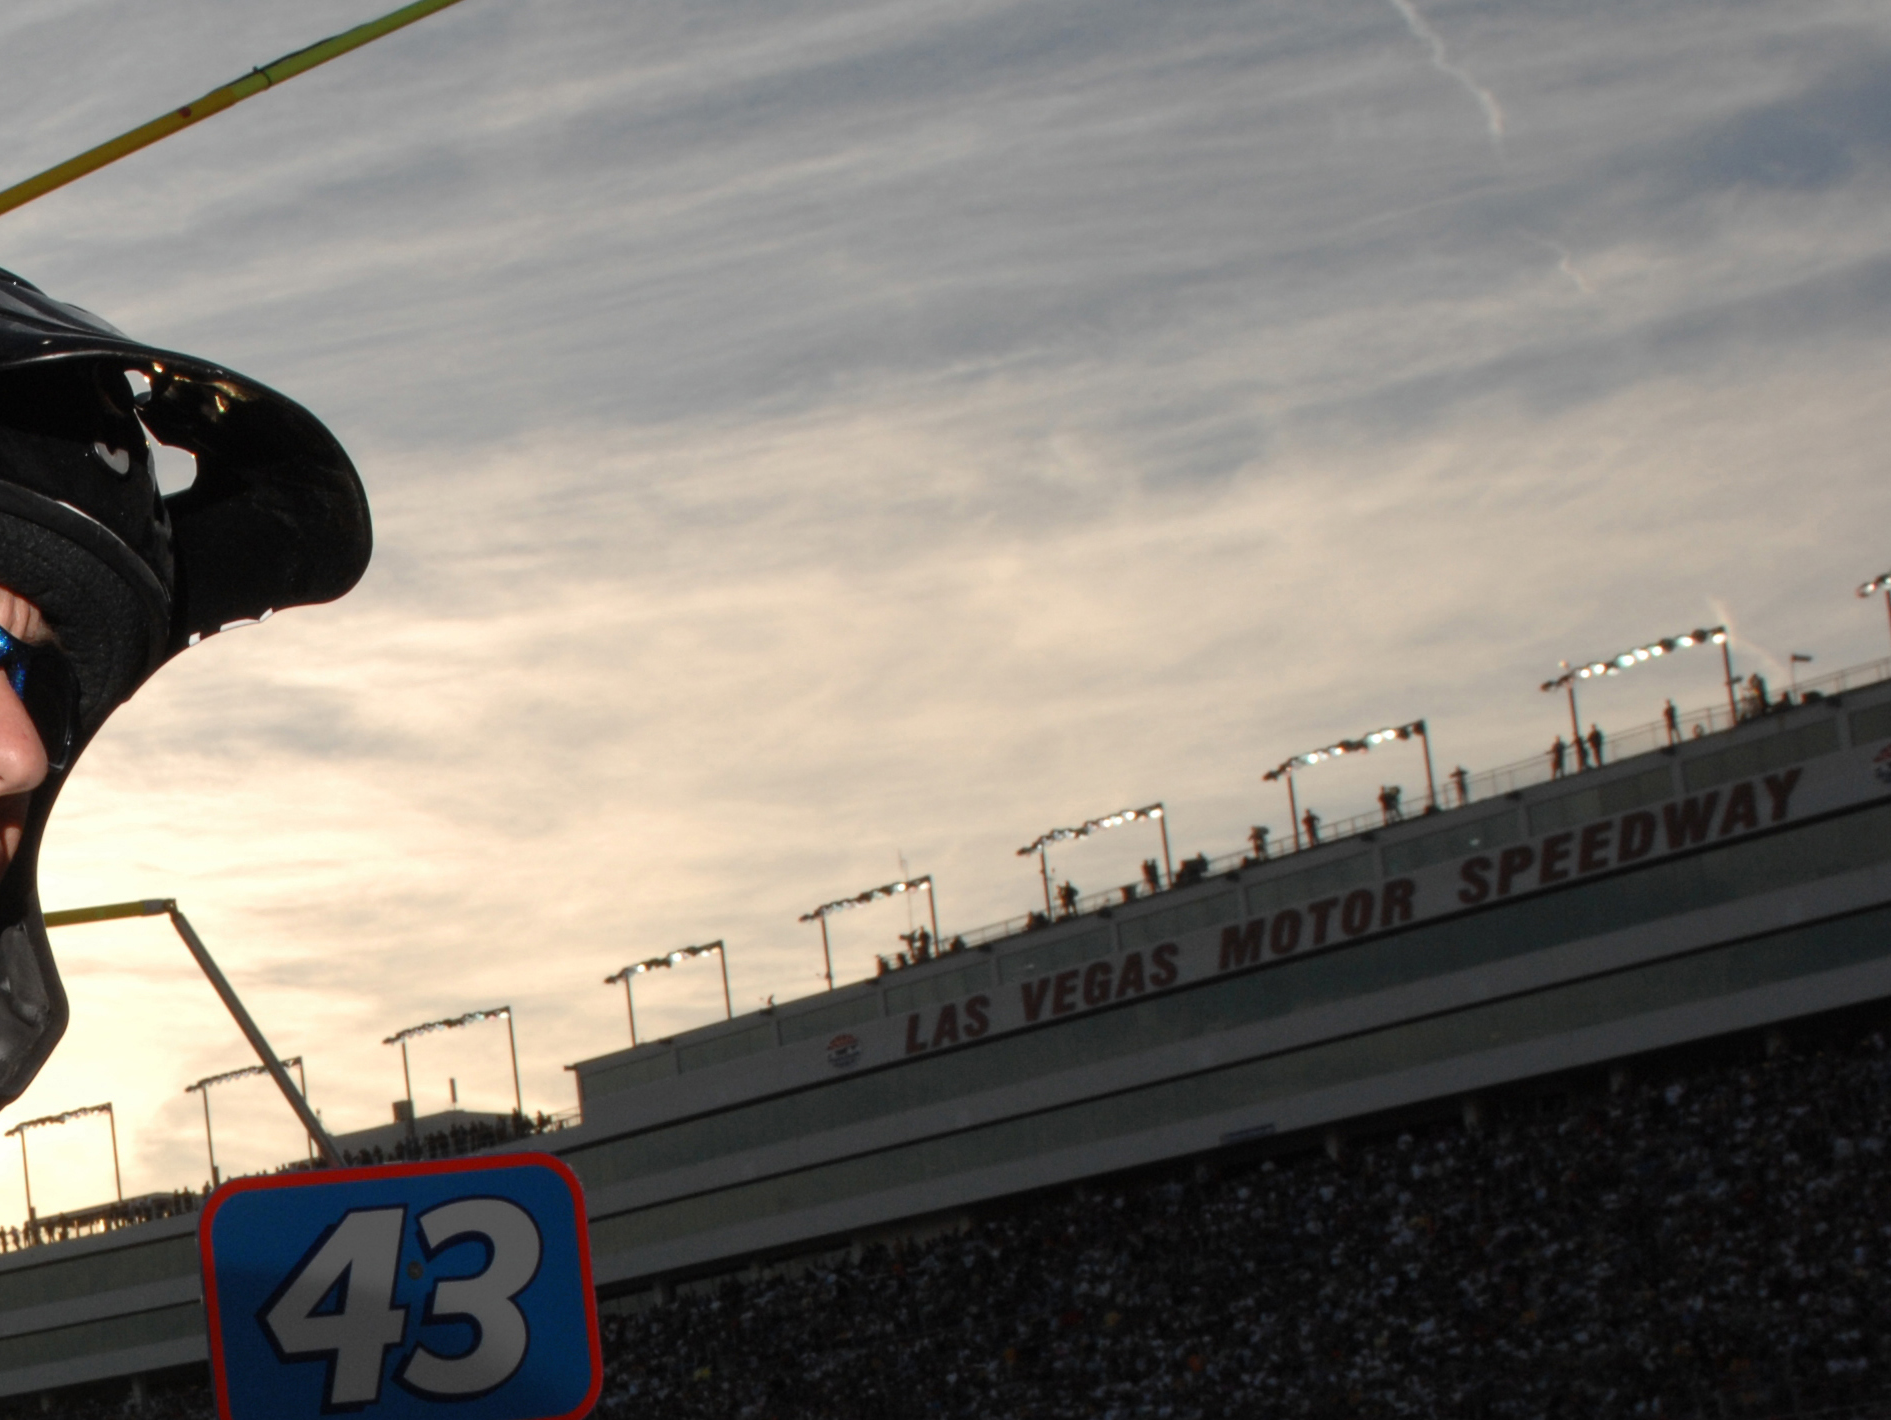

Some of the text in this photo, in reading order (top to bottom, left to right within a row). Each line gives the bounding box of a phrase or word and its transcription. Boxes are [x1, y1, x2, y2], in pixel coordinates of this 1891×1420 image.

[905, 995, 990, 1055] LAS
[1020, 942, 1179, 1022] VEGAS
[1218, 878, 1415, 970] MOTOR
[1458, 767, 1804, 905] SPEEDWAY
[257, 1194, 542, 1412] 43
